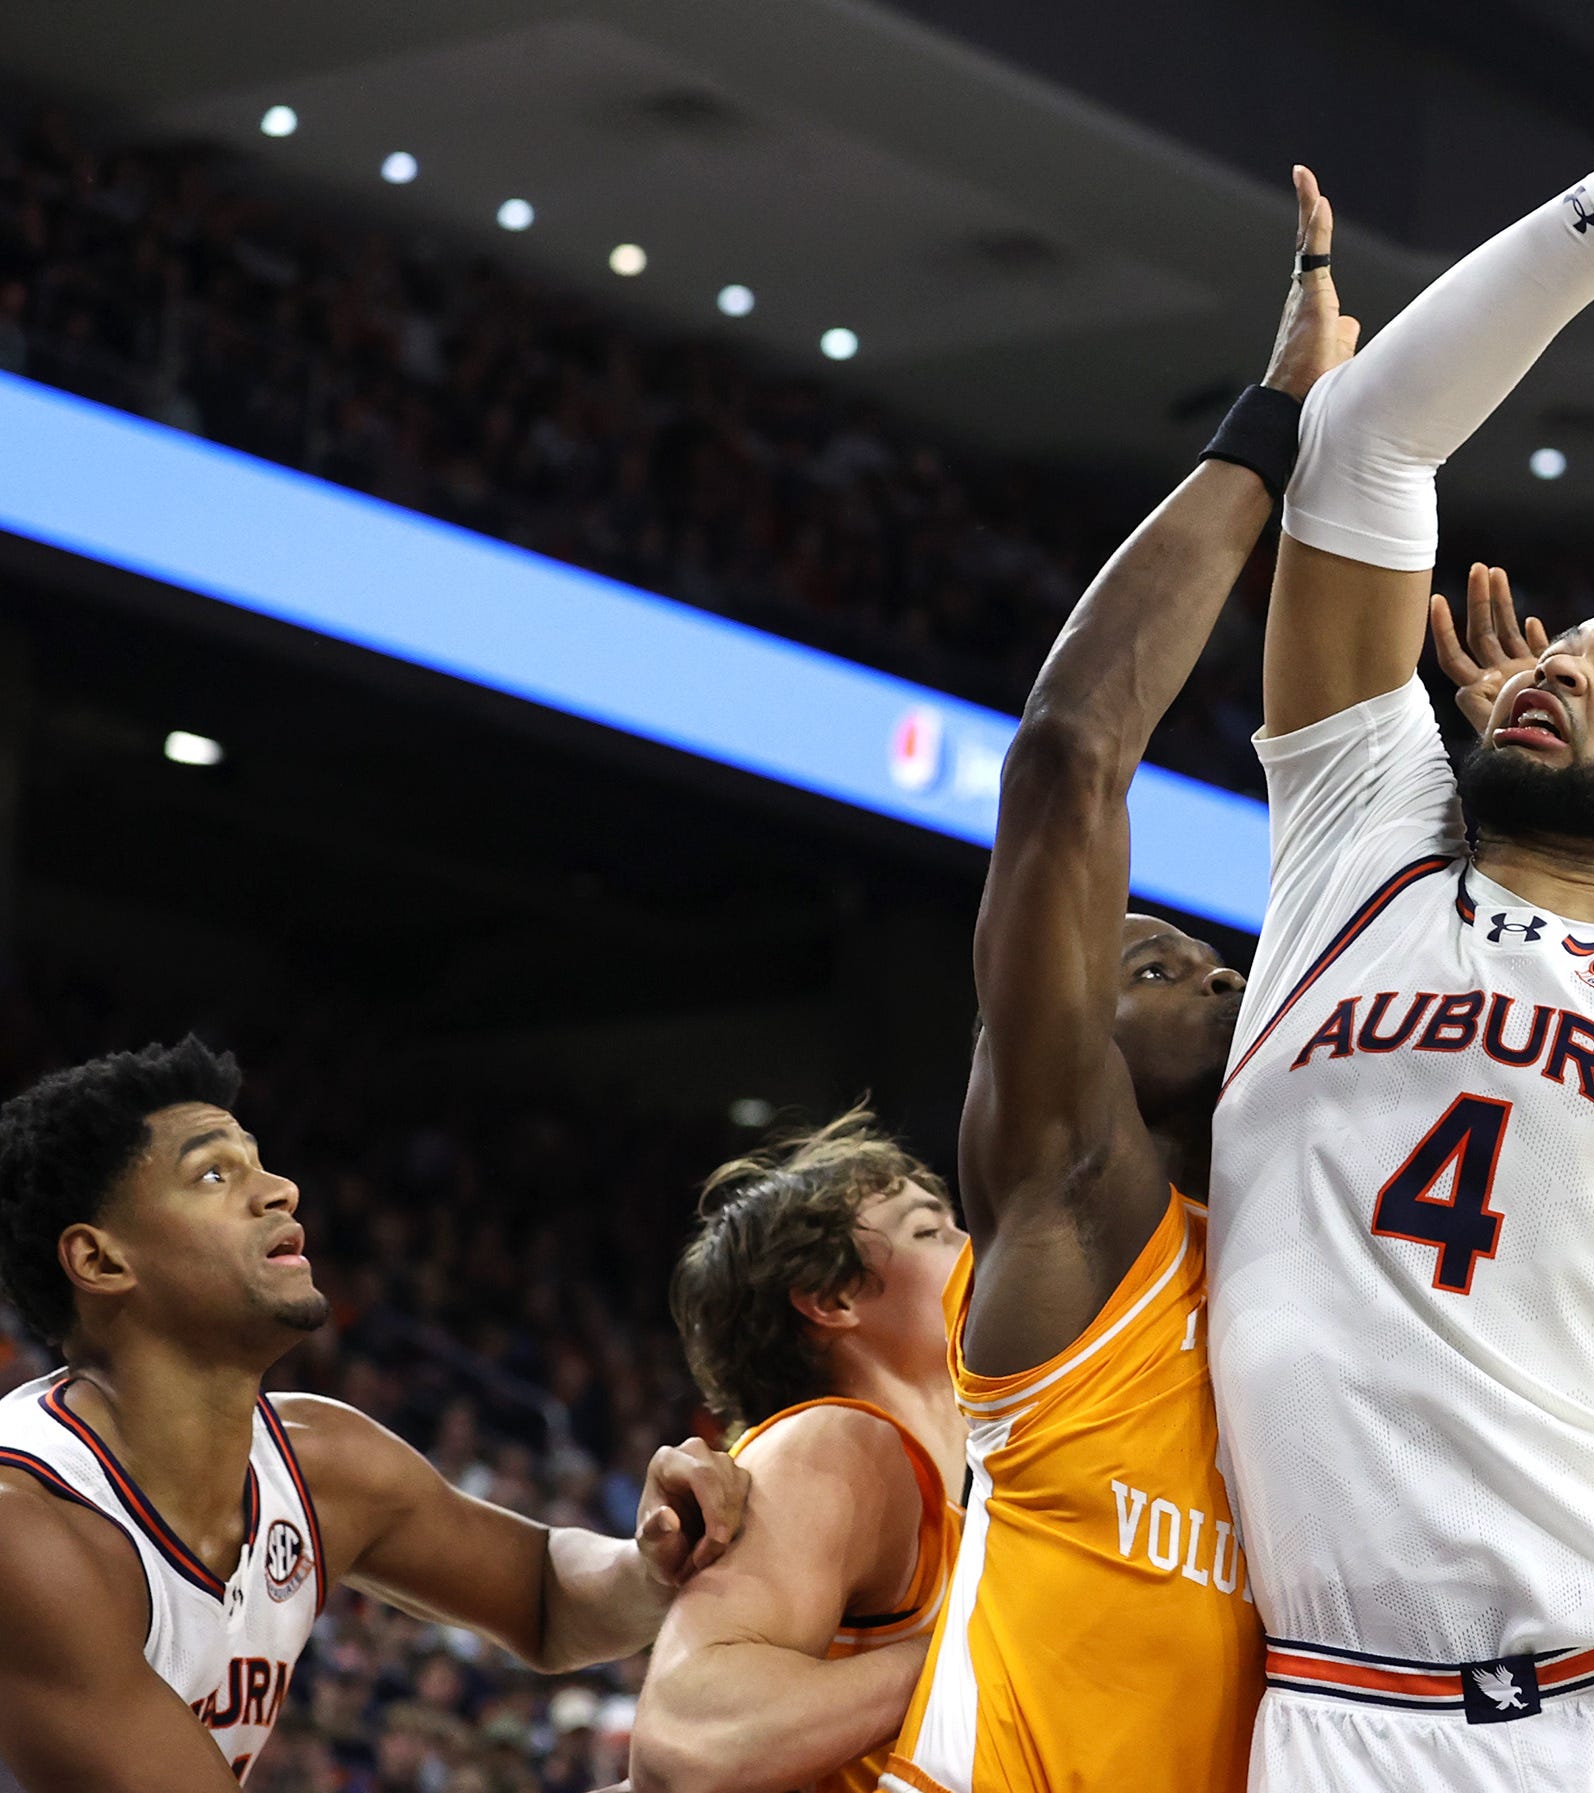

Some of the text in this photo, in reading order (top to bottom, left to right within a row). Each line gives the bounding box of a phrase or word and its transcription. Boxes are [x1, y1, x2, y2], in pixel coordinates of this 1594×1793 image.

[1371, 1091, 1513, 1296] 4
[268, 1523, 299, 1581] SEC
[1111, 1479, 1253, 1604] VOLU
